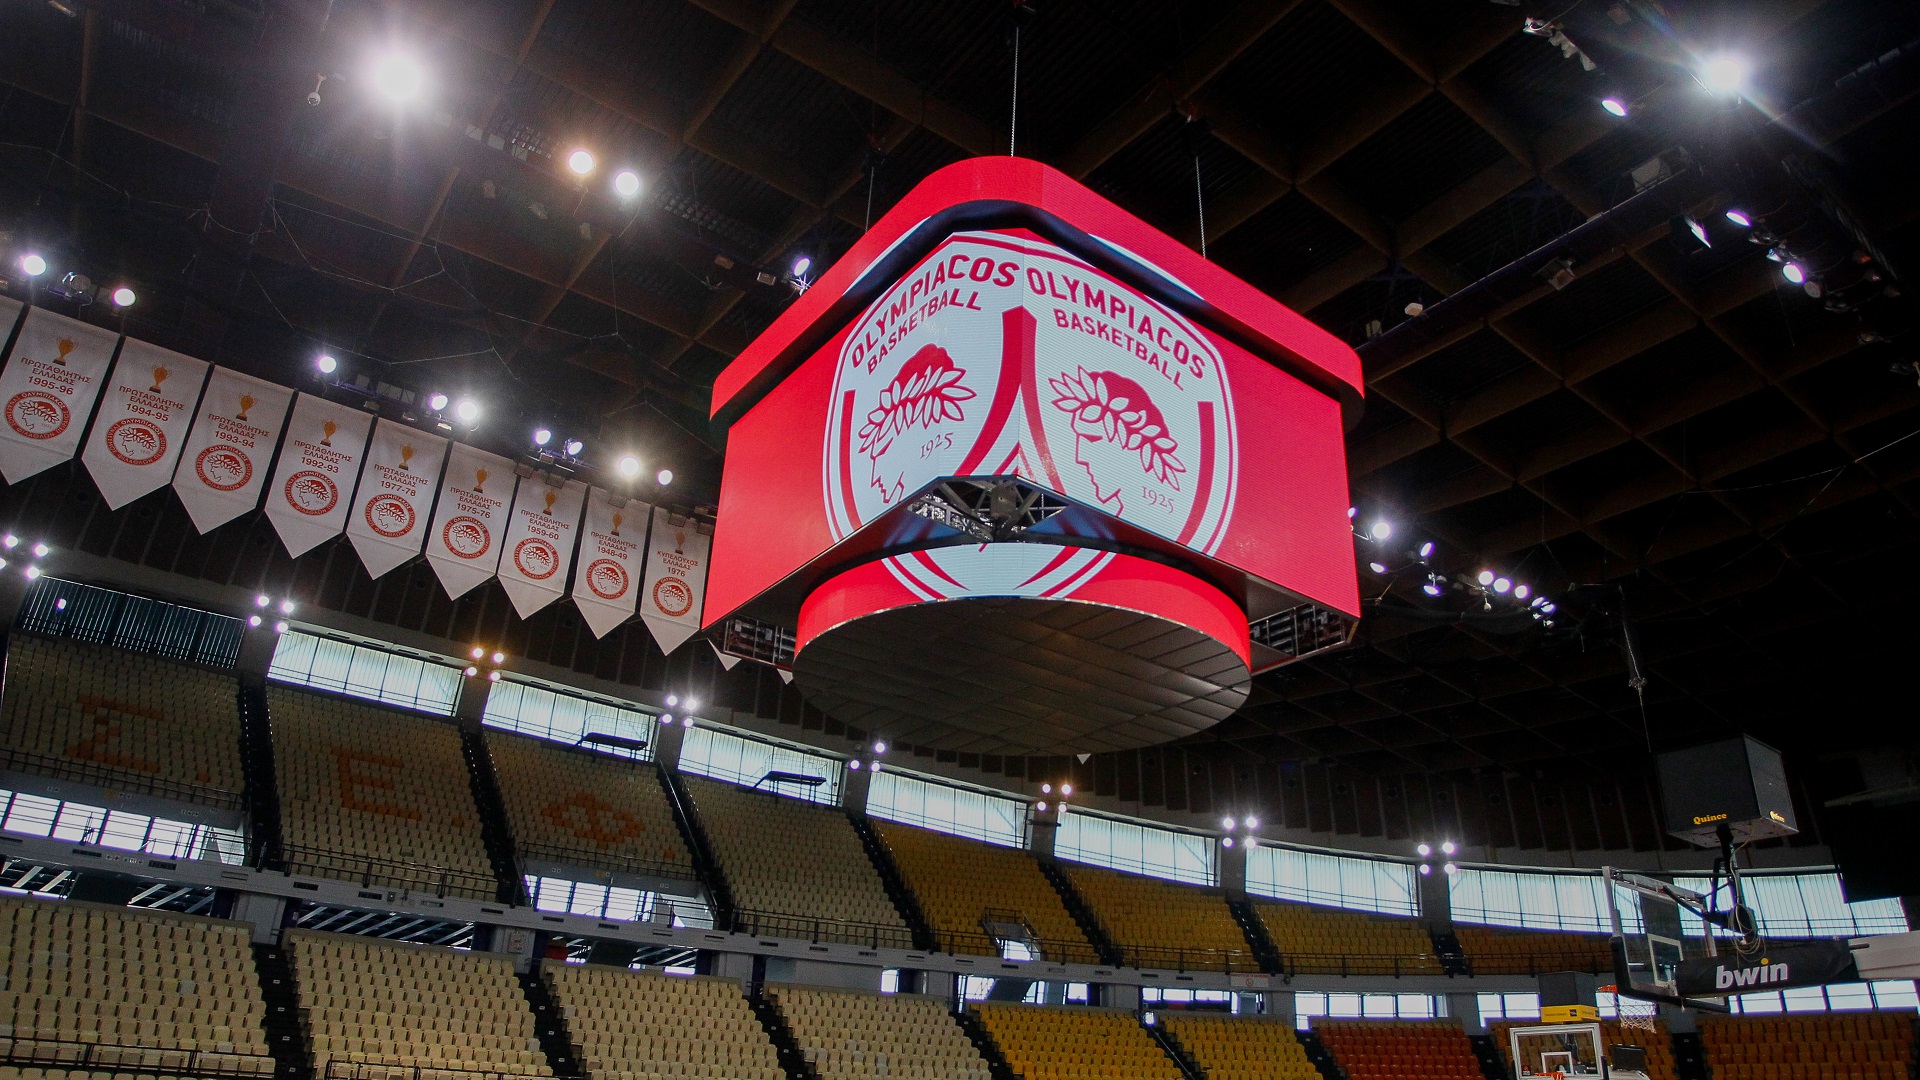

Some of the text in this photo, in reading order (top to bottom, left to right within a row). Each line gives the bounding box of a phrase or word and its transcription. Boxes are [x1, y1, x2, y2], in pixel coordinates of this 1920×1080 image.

[851, 254, 1021, 368] OLYMPIACOS
[867, 287, 982, 376] BASKETBALL
[1026, 267, 1206, 380] OLYMPIACOS
[1053, 309, 1185, 392] BASKETBALL
[21, 357, 92, 384] ΠΡΩΤΑΘΛΗΤΗΣ
[32, 367, 75, 386] ΕΛΛΑΔΑΣ
[28, 376, 74, 395] 1995-96
[21, 391, 65, 409] ΟΛΥΜΠΙΑΚΟΣ
[119, 386, 185, 411] ΠΡΩΤΑΘΛΗΤΗΣ
[129, 395, 170, 412] ΕΛΛΑΔΑΣ
[126, 403, 169, 422] 1994-95
[121, 418, 162, 435] ΟΛΥΜΠΙΑΚΟΣ
[208, 413, 270, 437] ΠΡΩΤΑΘΛΗΤΗΣ
[218, 423, 255, 439] ΕΛΛΑΔΑΣ
[214, 430, 255, 449] 1993-94
[919, 432, 954, 461] 1925
[294, 440, 352, 462] ΠΡΩΤΑΘΛΗΤΗΣ
[304, 449, 340, 465] ΕΛΛΑΔΑΣ
[301, 457, 339, 474] 1992-93
[374, 464, 429, 485] ΠΡΩΤΑΘΛΗΤΗΣ
[380, 480, 417, 497] 1977-78
[383, 472, 417, 487] ΕΛΛΑΔΑΣ
[450, 487, 502, 508] ΠΡΩΤΑΘΛΗΤΗΣ
[459, 495, 491, 510] ΕΛΛΑΔΑΣ
[1141, 486, 1175, 514] 1925
[456, 503, 491, 519] 1975-76
[521, 509, 570, 530] ΠΡΩΤΑΘΛΗΤΗΣ
[527, 525, 560, 540] 1959-60
[529, 517, 560, 532] ΕΛΛΑΔΑΣ
[591, 531, 637, 550] ΠΡΩΤΑΘΛΗΤΗΣ
[598, 539, 627, 552] ΕΛΛΑΔΑΣ
[597, 546, 629, 560] 1948-49
[657, 550, 699, 567] ΚΥΠΕΛΟΥΧΟΣ
[662, 557, 692, 570] ΕΛΛΑΔΑΣ
[667, 567, 686, 577] 1976
[1693, 813, 1727, 825] Quince
[1715, 957, 1788, 989] bwin
